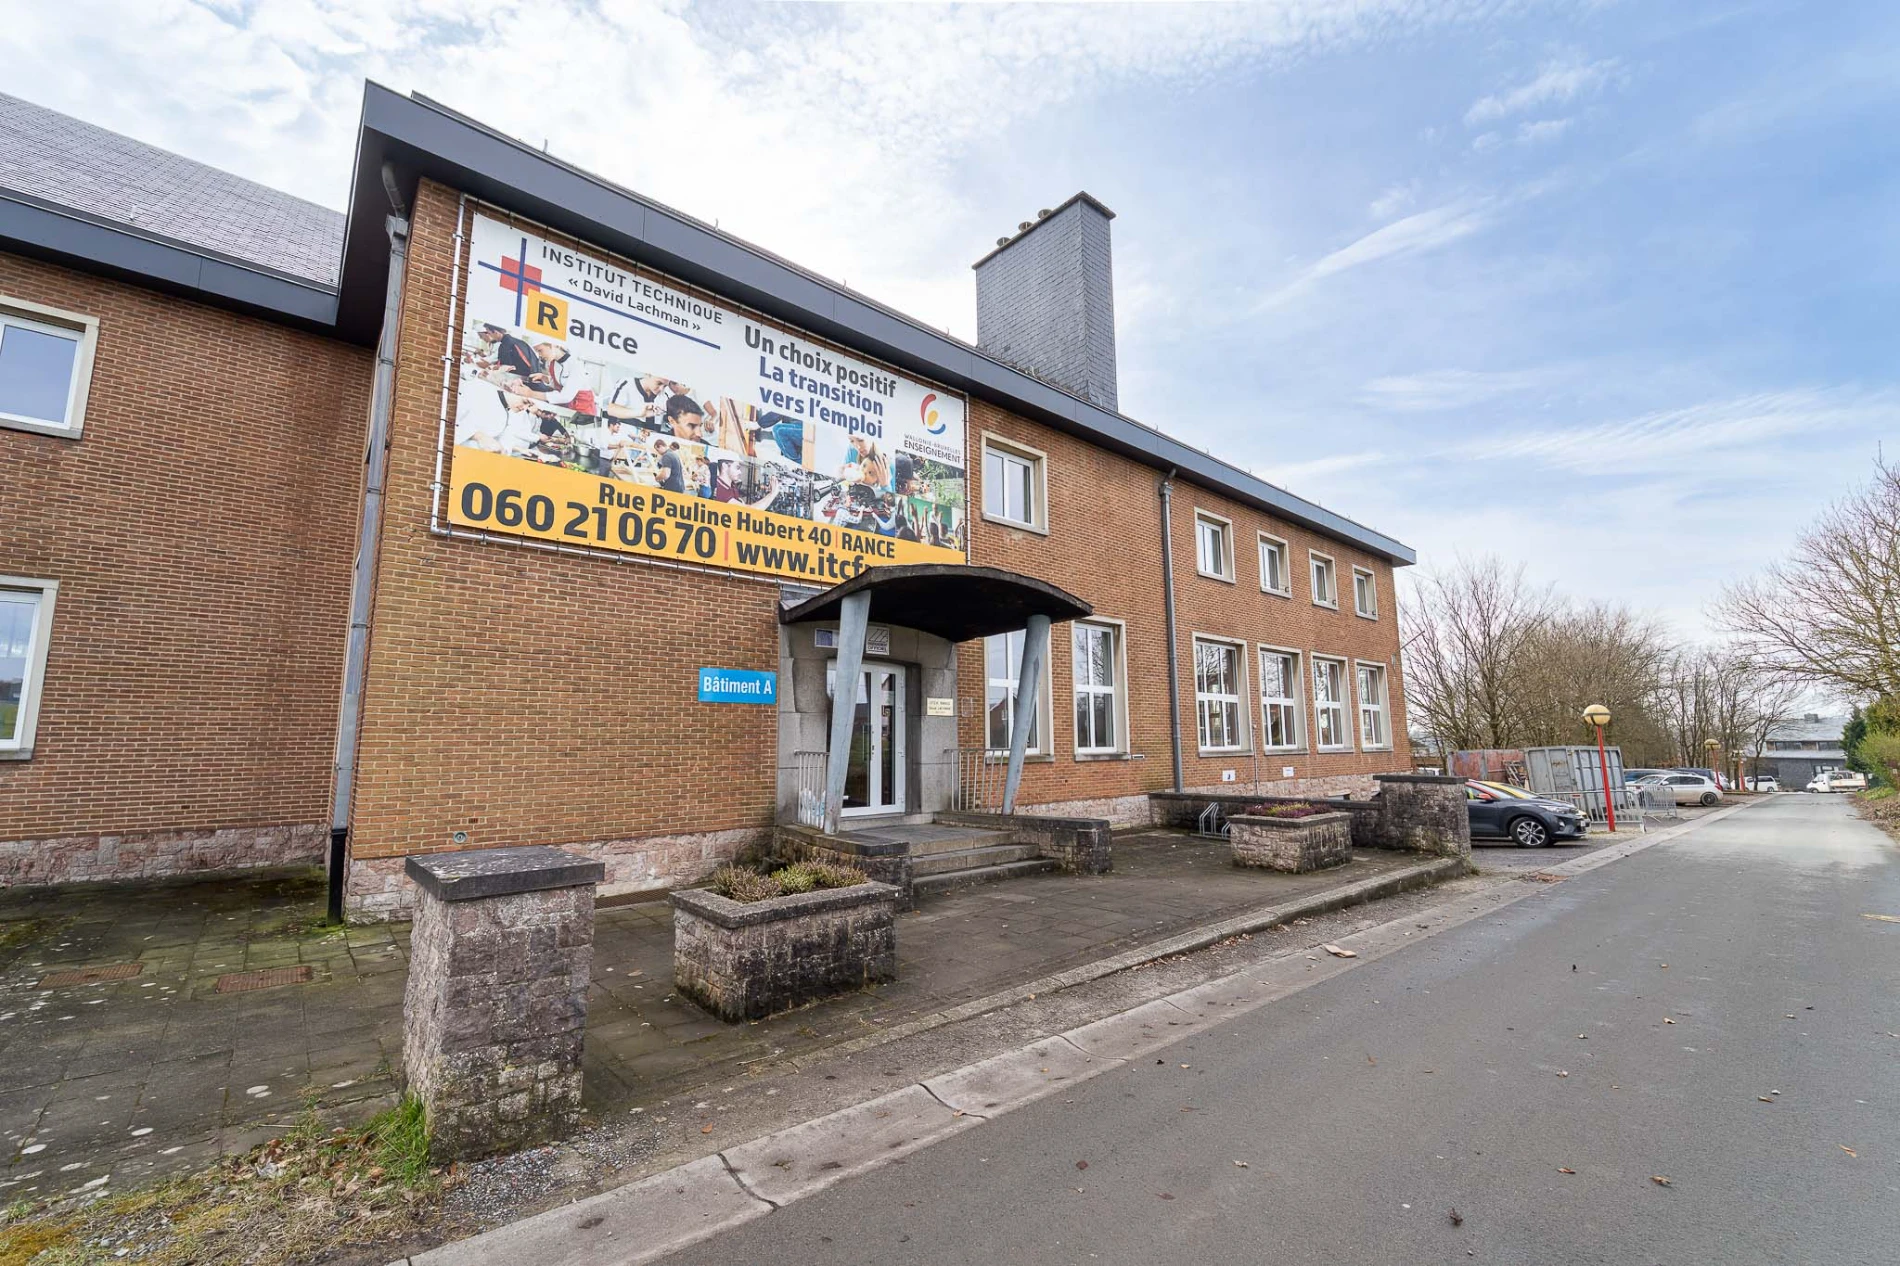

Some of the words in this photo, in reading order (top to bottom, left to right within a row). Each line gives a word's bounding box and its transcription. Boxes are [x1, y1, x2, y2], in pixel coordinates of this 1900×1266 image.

[542, 245, 627, 288] INSTITUT
[632, 279, 723, 324] TECHNIQUE
[582, 279, 624, 304] David
[627, 291, 689, 329] Lachman
[536, 300, 639, 355] Rance
[744, 324, 774, 356] Un
[779, 341, 832, 376] choix
[836, 365, 897, 398] positif
[759, 356, 784, 384] La
[788, 368, 884, 418] transition
[759, 386, 805, 416] vers
[809, 398, 883, 440] l'emploi
[904, 440, 961, 464] ENSEIGNEMENT
[461, 482, 555, 532] 060
[563, 501, 608, 541] 21
[618, 511, 667, 551] 06
[674, 521, 717, 559] 70
[736, 540, 871, 581] www.itcf
[599, 482, 646, 512] Rue
[651, 493, 732, 529] Pauline
[736, 511, 805, 543] Hubert
[807, 526, 832, 547] 40
[841, 532, 895, 559] RANCE
[703, 676, 761, 695] Bâtiment
[763, 680, 772, 695] A
